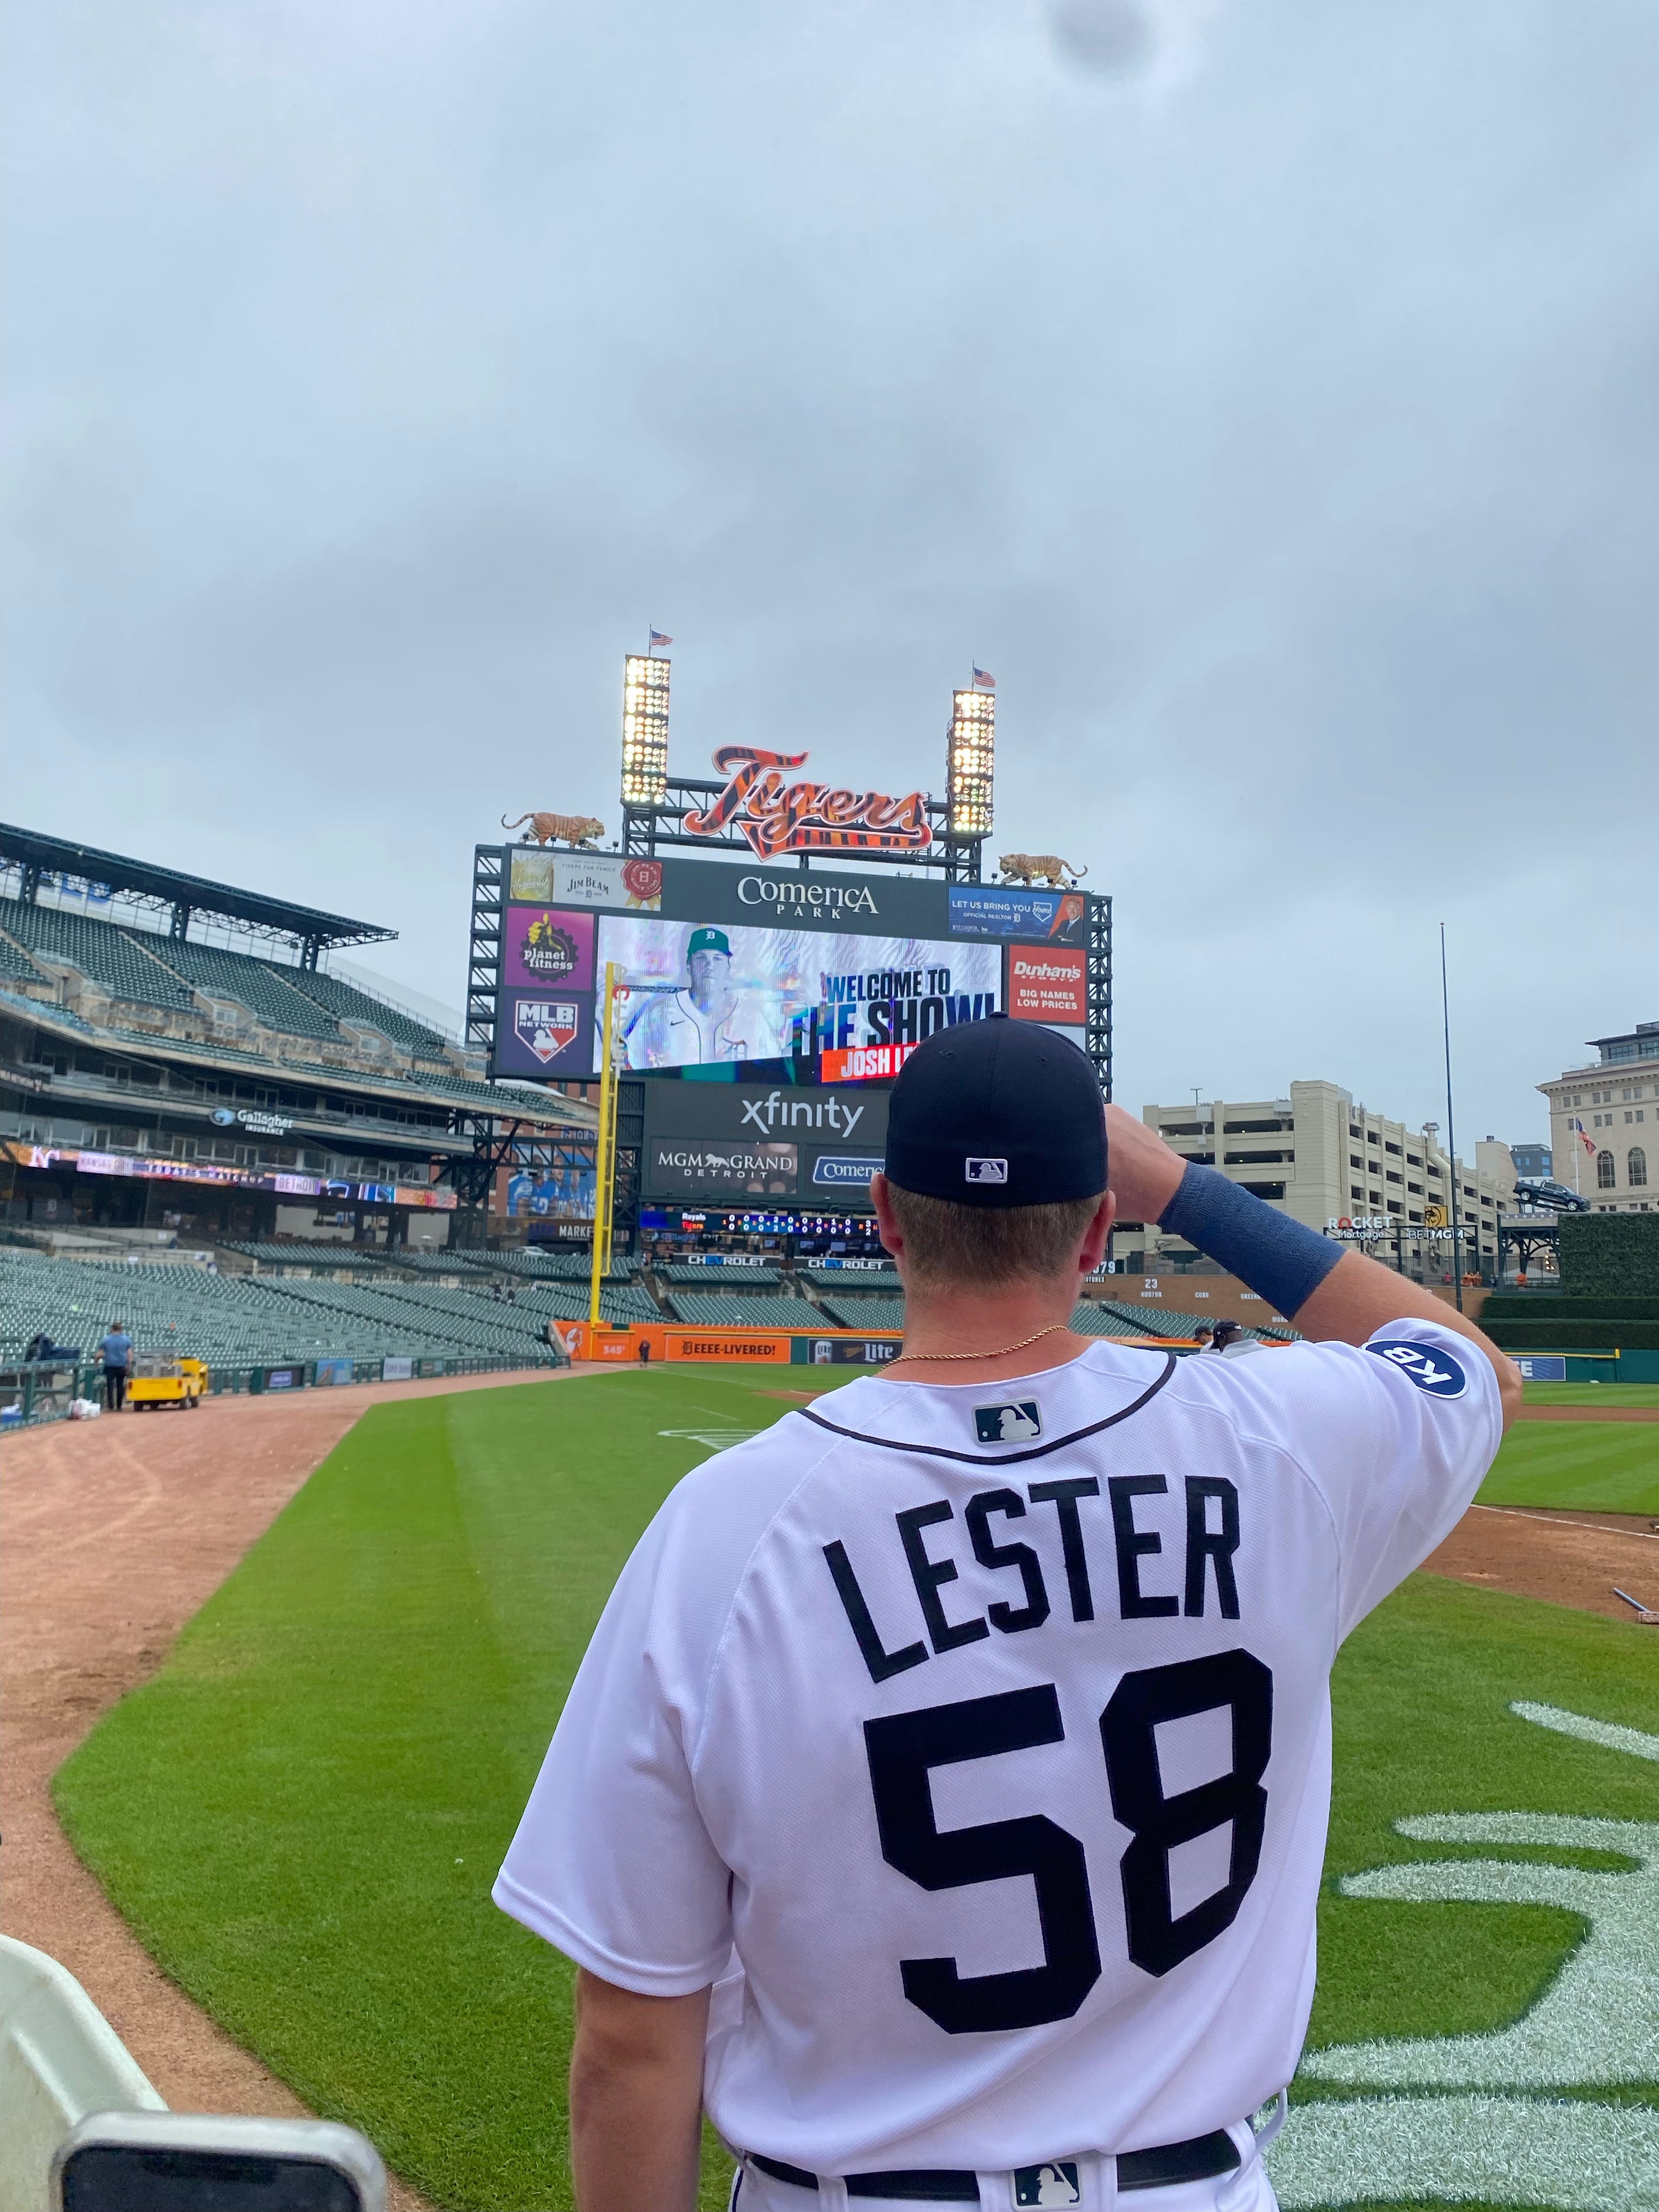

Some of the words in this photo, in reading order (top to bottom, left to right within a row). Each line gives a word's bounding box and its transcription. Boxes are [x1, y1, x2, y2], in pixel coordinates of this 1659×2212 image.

[682, 743, 933, 862] Tigers
[567, 878, 584, 893] JIM
[585, 877, 608, 895] BEAM
[776, 904, 841, 919] PARK
[984, 902, 1010, 911] BRING
[1013, 904, 1030, 912] YOU
[1032, 905, 1052, 913] Home
[523, 947, 566, 961] planet
[529, 958, 573, 970] fitness
[1014, 961, 1081, 979] Dunham's
[826, 970, 923, 1004] WELCOME
[927, 968, 950, 995] TO
[1020, 989, 1037, 998] BIG
[1040, 991, 1075, 1000] NAMES
[1017, 999, 1039, 1007] LOW
[1042, 1000, 1077, 1010] PRICES
[519, 1003, 574, 1023] MLB
[519, 1021, 574, 1030] NETWORK
[840, 1046, 890, 1077] JOSH
[237, 1109, 293, 1129] Gallagher
[741, 1091, 864, 1138] xfinity
[245, 1124, 284, 1136] INSURANCE
[658, 1152, 702, 1167] MGM
[730, 1155, 793, 1171] GRAND
[684, 1169, 768, 1179] DETROIT
[823, 1163, 885, 1178] Comeric
[682, 1212, 706, 1221] Royals
[1328, 1216, 1393, 1229] ROCKET
[559, 1225, 593, 1237] MARKE
[682, 1221, 704, 1231] Tigers
[1338, 1229, 1384, 1240] Mortgage
[1408, 1229, 1464, 1239] BETMGM
[688, 1255, 765, 1266] CHEVROLET
[808, 1259, 884, 1270] CHEVROLET
[1145, 1279, 1158, 1289] 23
[864, 1343, 894, 1362] Lite
[1383, 1346, 1453, 1385] KB
[823, 1474, 1241, 1684] LESTER
[864, 1648, 1273, 2034] 58
